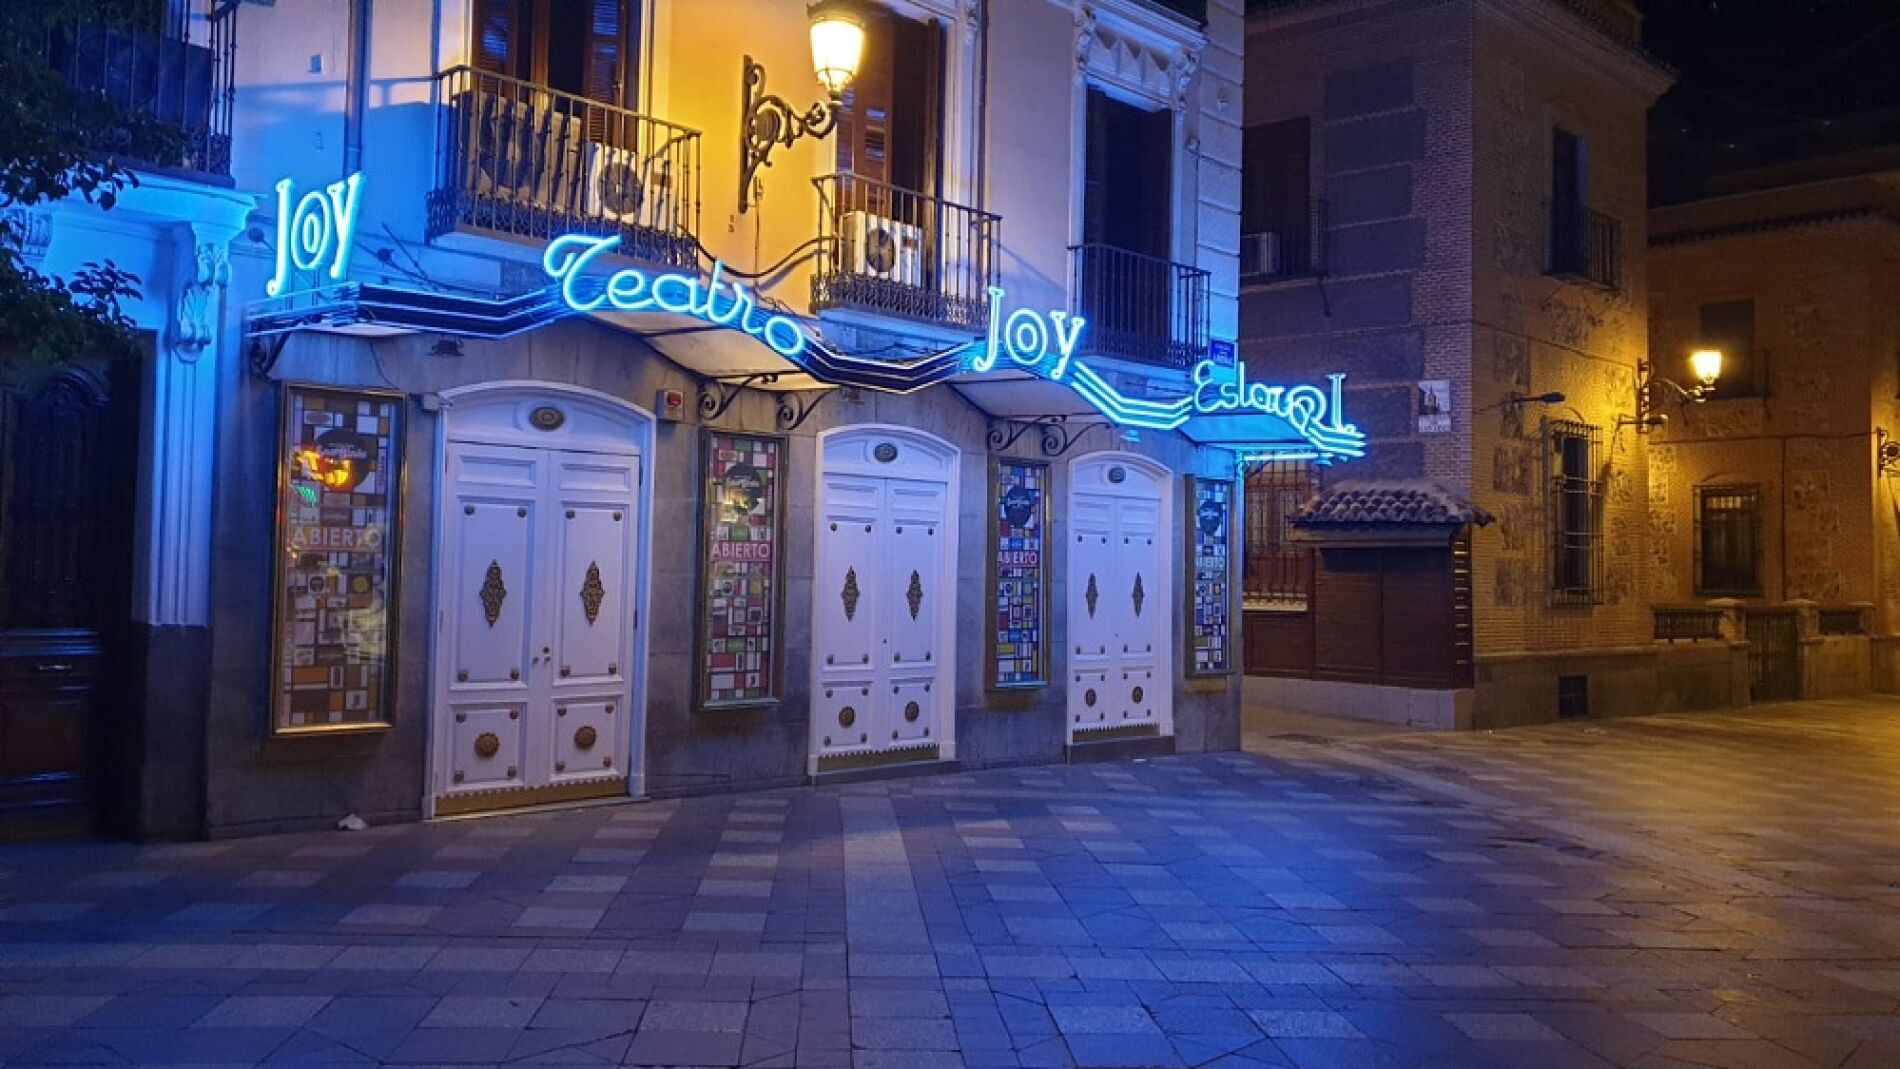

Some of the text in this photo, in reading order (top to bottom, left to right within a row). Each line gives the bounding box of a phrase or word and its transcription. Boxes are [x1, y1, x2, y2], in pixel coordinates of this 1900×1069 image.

[543, 234, 807, 357] Teatro
[293, 527, 382, 546] ABIERTO
[712, 543, 769, 558] ABIERTO
